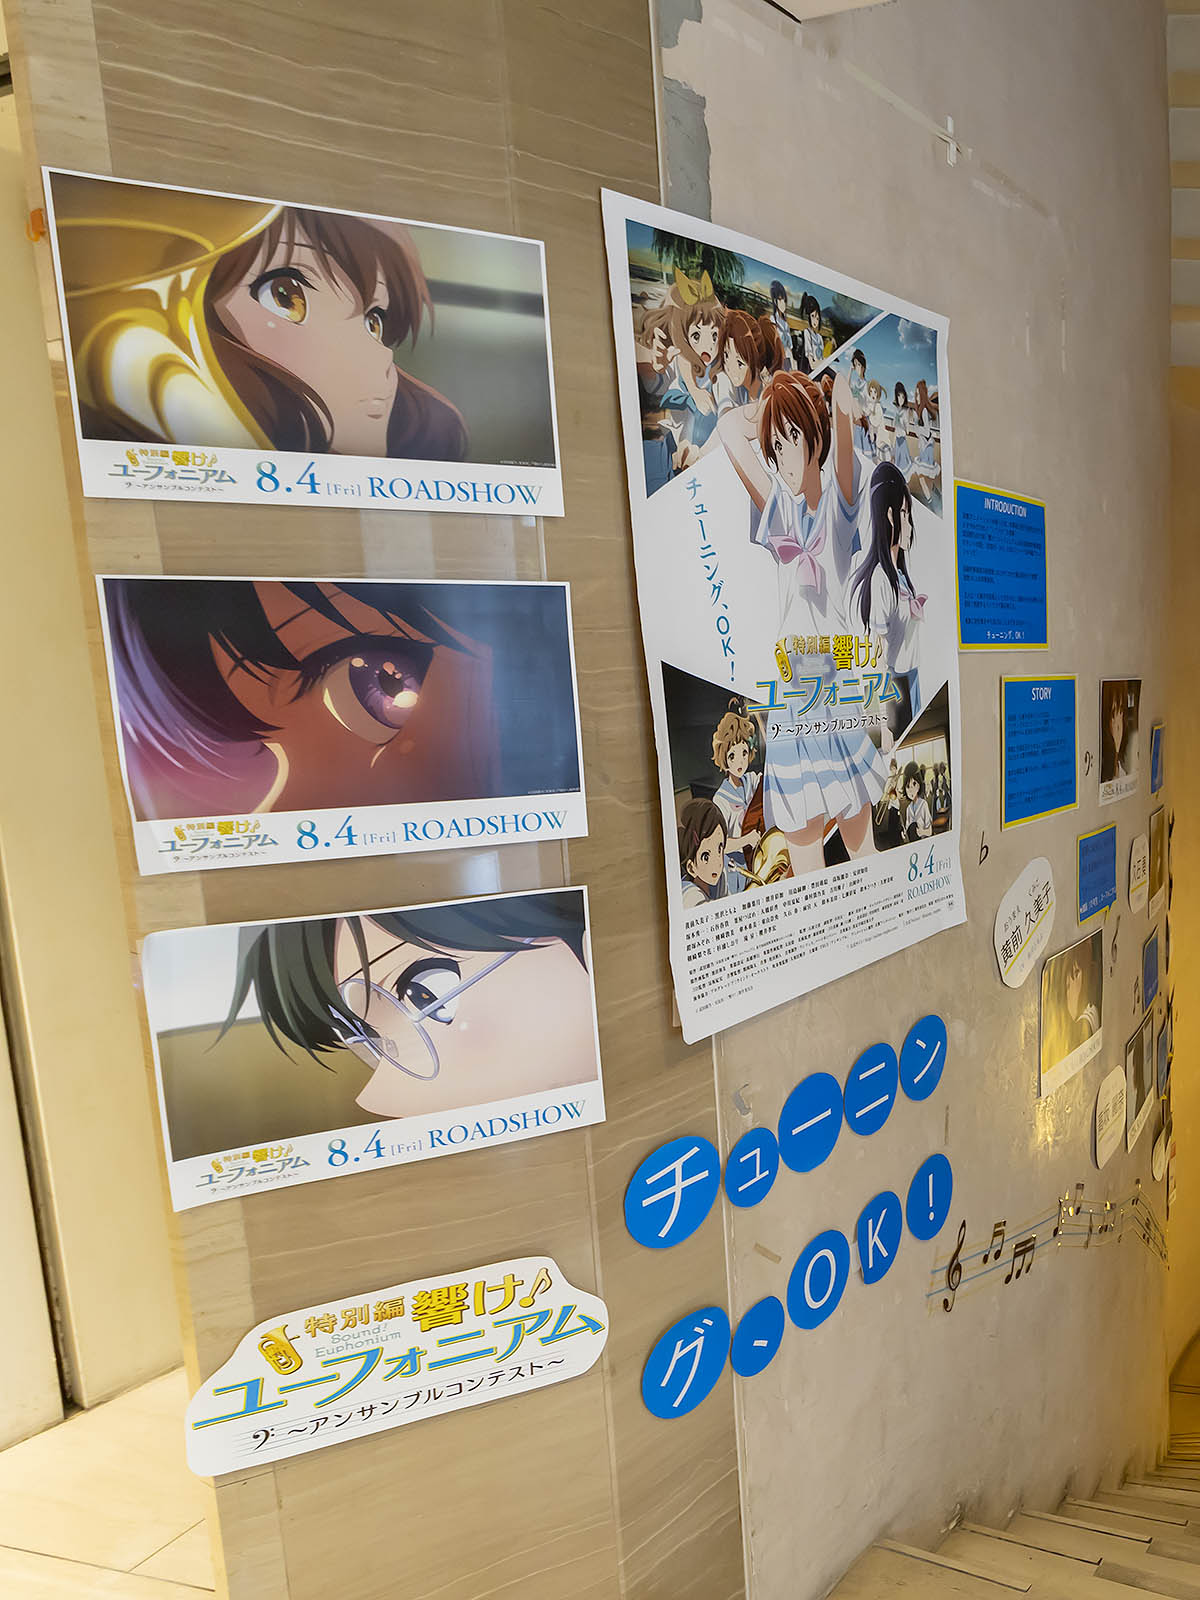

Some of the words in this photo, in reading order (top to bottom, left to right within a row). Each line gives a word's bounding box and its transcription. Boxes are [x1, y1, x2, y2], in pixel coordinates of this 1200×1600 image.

[108, 463, 238, 485] ユーフォニアム
[256, 460, 321, 495] 8.4
[367, 476, 543, 505] ROADSHOW
[984, 497, 1027, 518] INTRODUCTION
[792, 635, 831, 656] 特別編
[745, 672, 903, 717] ユーフォニアム
[1031, 687, 1052, 701] STORY
[158, 833, 280, 854] ユーフォニアム
[296, 815, 358, 851] 8.4
[363, 830, 397, 845] [Fri]
[401, 809, 568, 842] ROADSHOW
[908, 844, 935, 883] 8.4
[907, 873, 952, 901] ROADSHOW
[327, 1129, 386, 1167] 8.4
[428, 1099, 586, 1149] ROADSHOW
[195, 1155, 312, 1188] ユーフォニアム
[303, 1294, 405, 1339] 特別編
[314, 1330, 402, 1359] Euphonium
[330, 1323, 388, 1345] Sound!
[192, 1303, 606, 1431] ユーフォニアム
